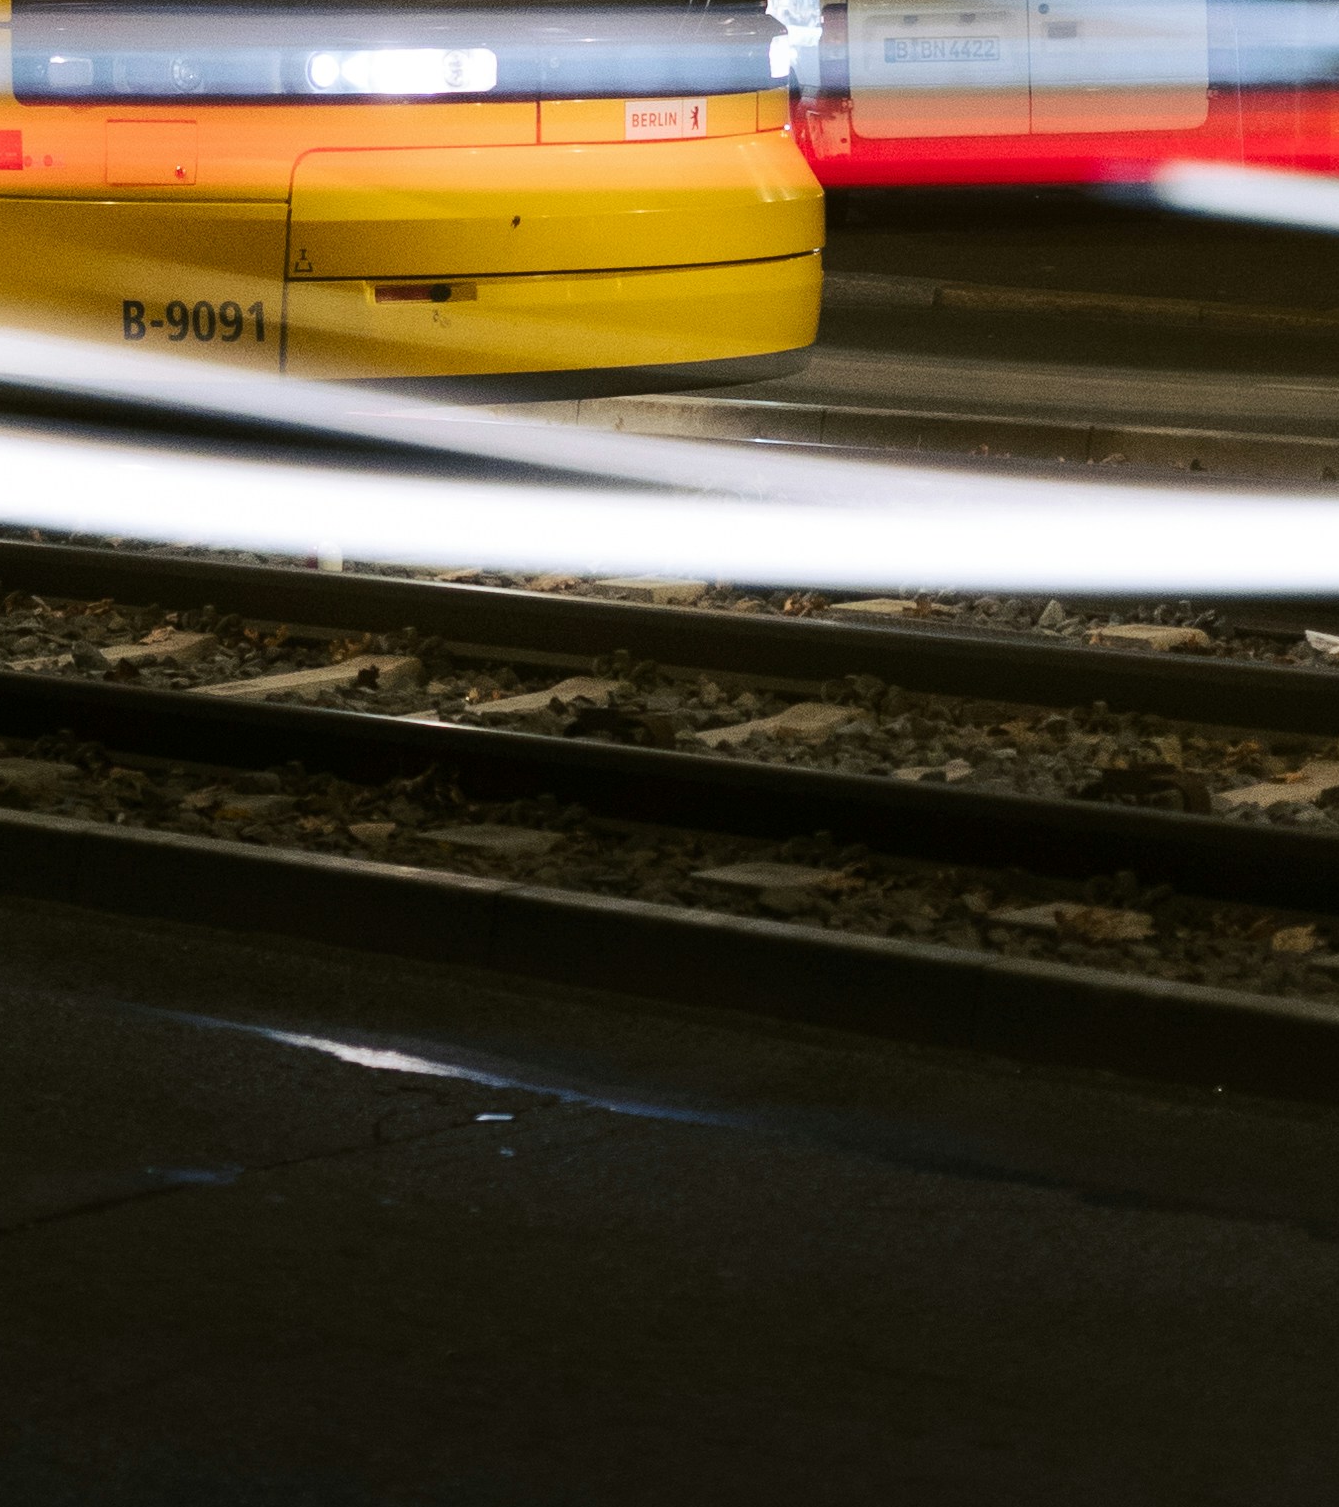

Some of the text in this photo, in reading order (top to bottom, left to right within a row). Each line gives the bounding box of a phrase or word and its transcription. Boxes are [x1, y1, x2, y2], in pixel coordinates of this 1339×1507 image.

[949, 39, 996, 58] 4422
[631, 111, 678, 128] BERLIN
[122, 299, 265, 343] B-9091
